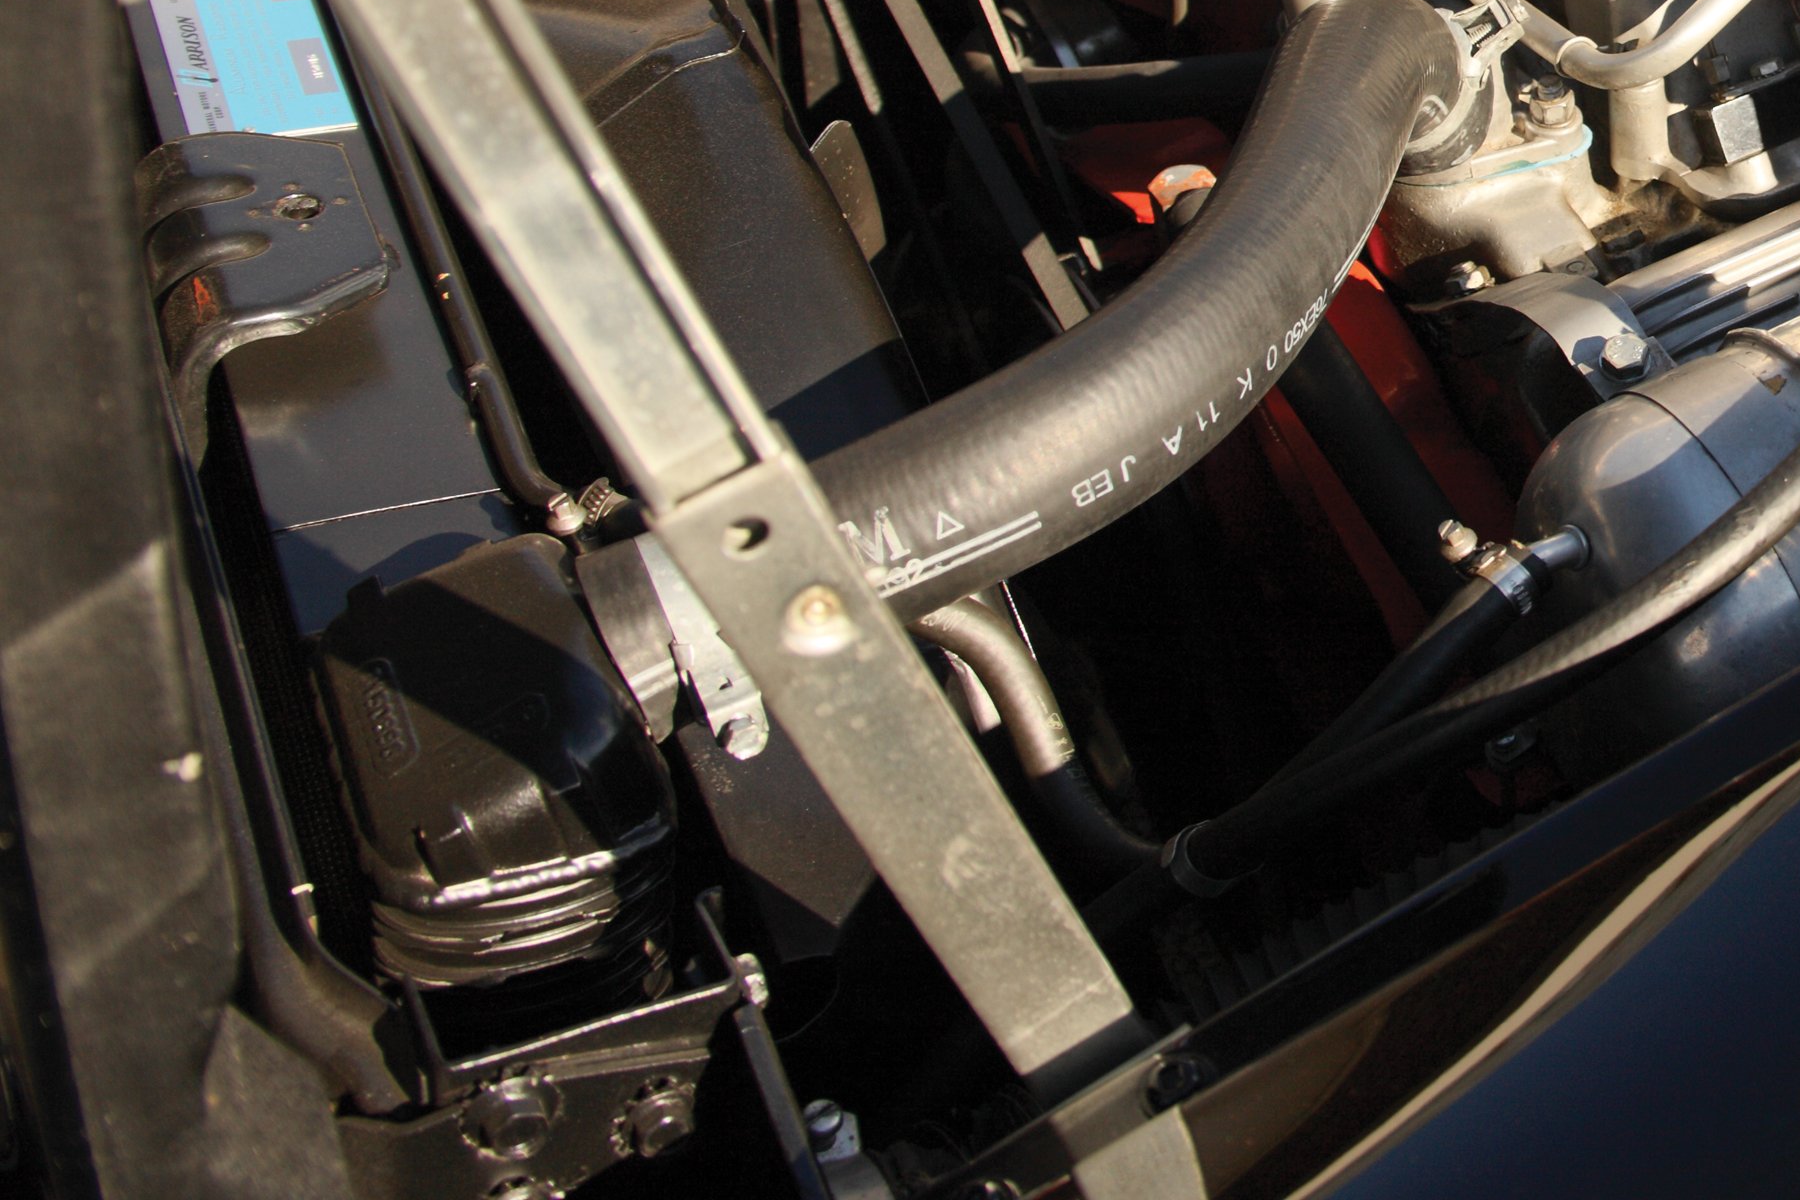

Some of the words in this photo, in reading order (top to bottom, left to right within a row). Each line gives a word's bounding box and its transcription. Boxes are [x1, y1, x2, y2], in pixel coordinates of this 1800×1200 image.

[1236, 367, 1253, 400] K
[1196, 401, 1221, 431] 11
[1161, 425, 1182, 455] A
